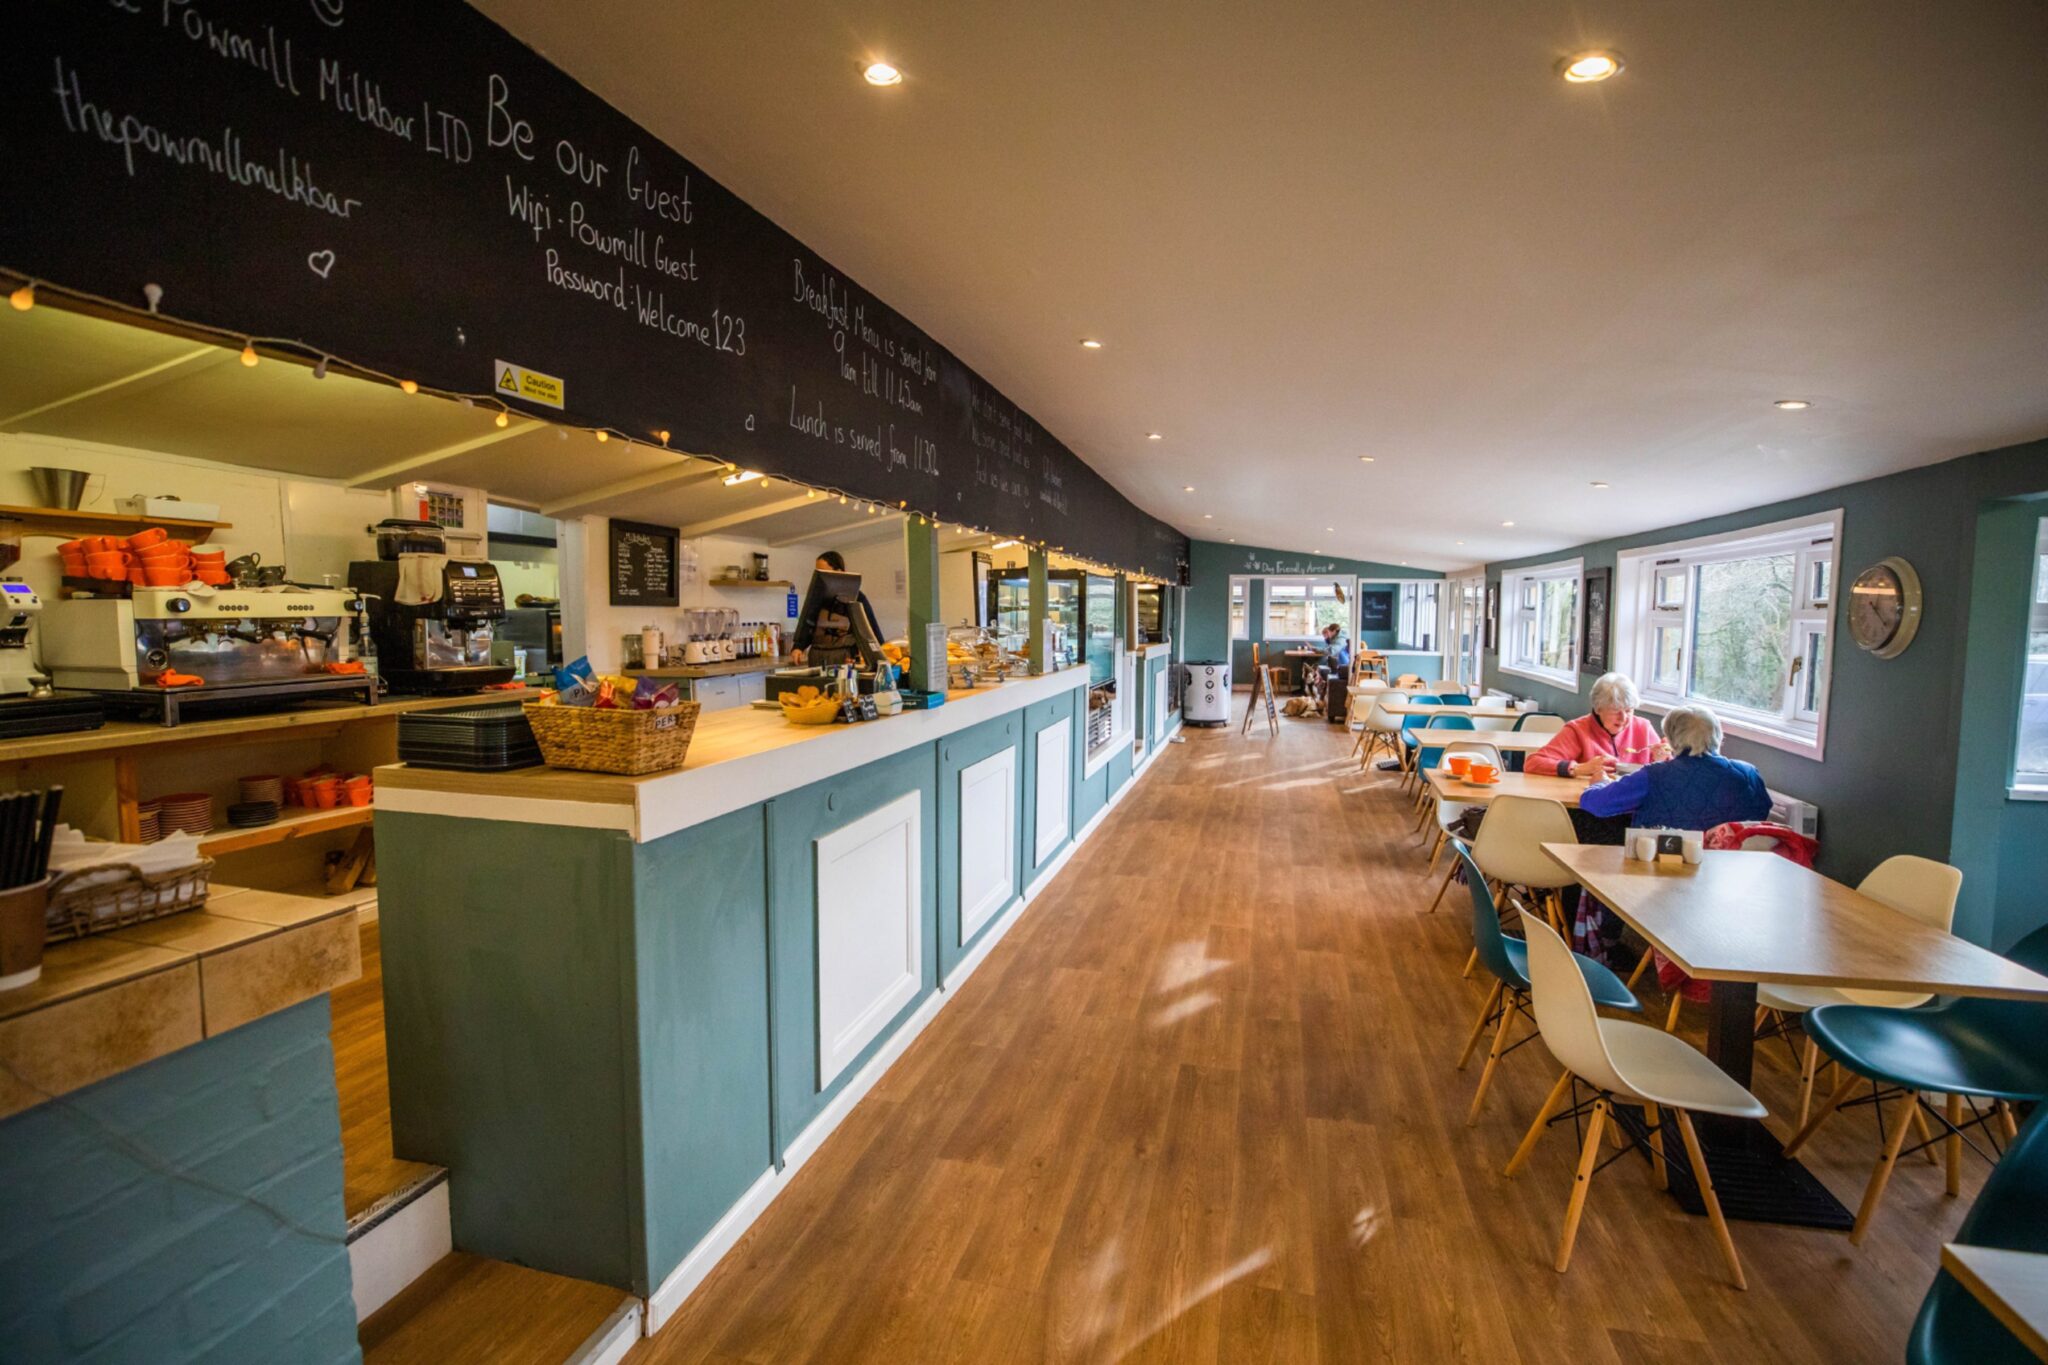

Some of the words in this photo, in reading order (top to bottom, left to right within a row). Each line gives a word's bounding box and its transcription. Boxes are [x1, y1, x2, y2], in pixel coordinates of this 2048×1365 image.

[320, 58, 415, 142] Milkbar
[423, 101, 473, 164] LTD
[487, 73, 535, 161] Be
[626, 145, 692, 225] Guest
[506, 174, 550, 243] Wifi
[570, 200, 648, 269] Powmill
[655, 234, 699, 282] Guest
[793, 258, 850, 331] Breakfast
[854, 304, 882, 353] Menu
[885, 338, 896, 358] is
[526, 375, 557, 391] Caution
[862, 351, 880, 398] till
[789, 383, 829, 441] Lunch
[834, 426, 845, 444] is
[887, 423, 909, 473] from
